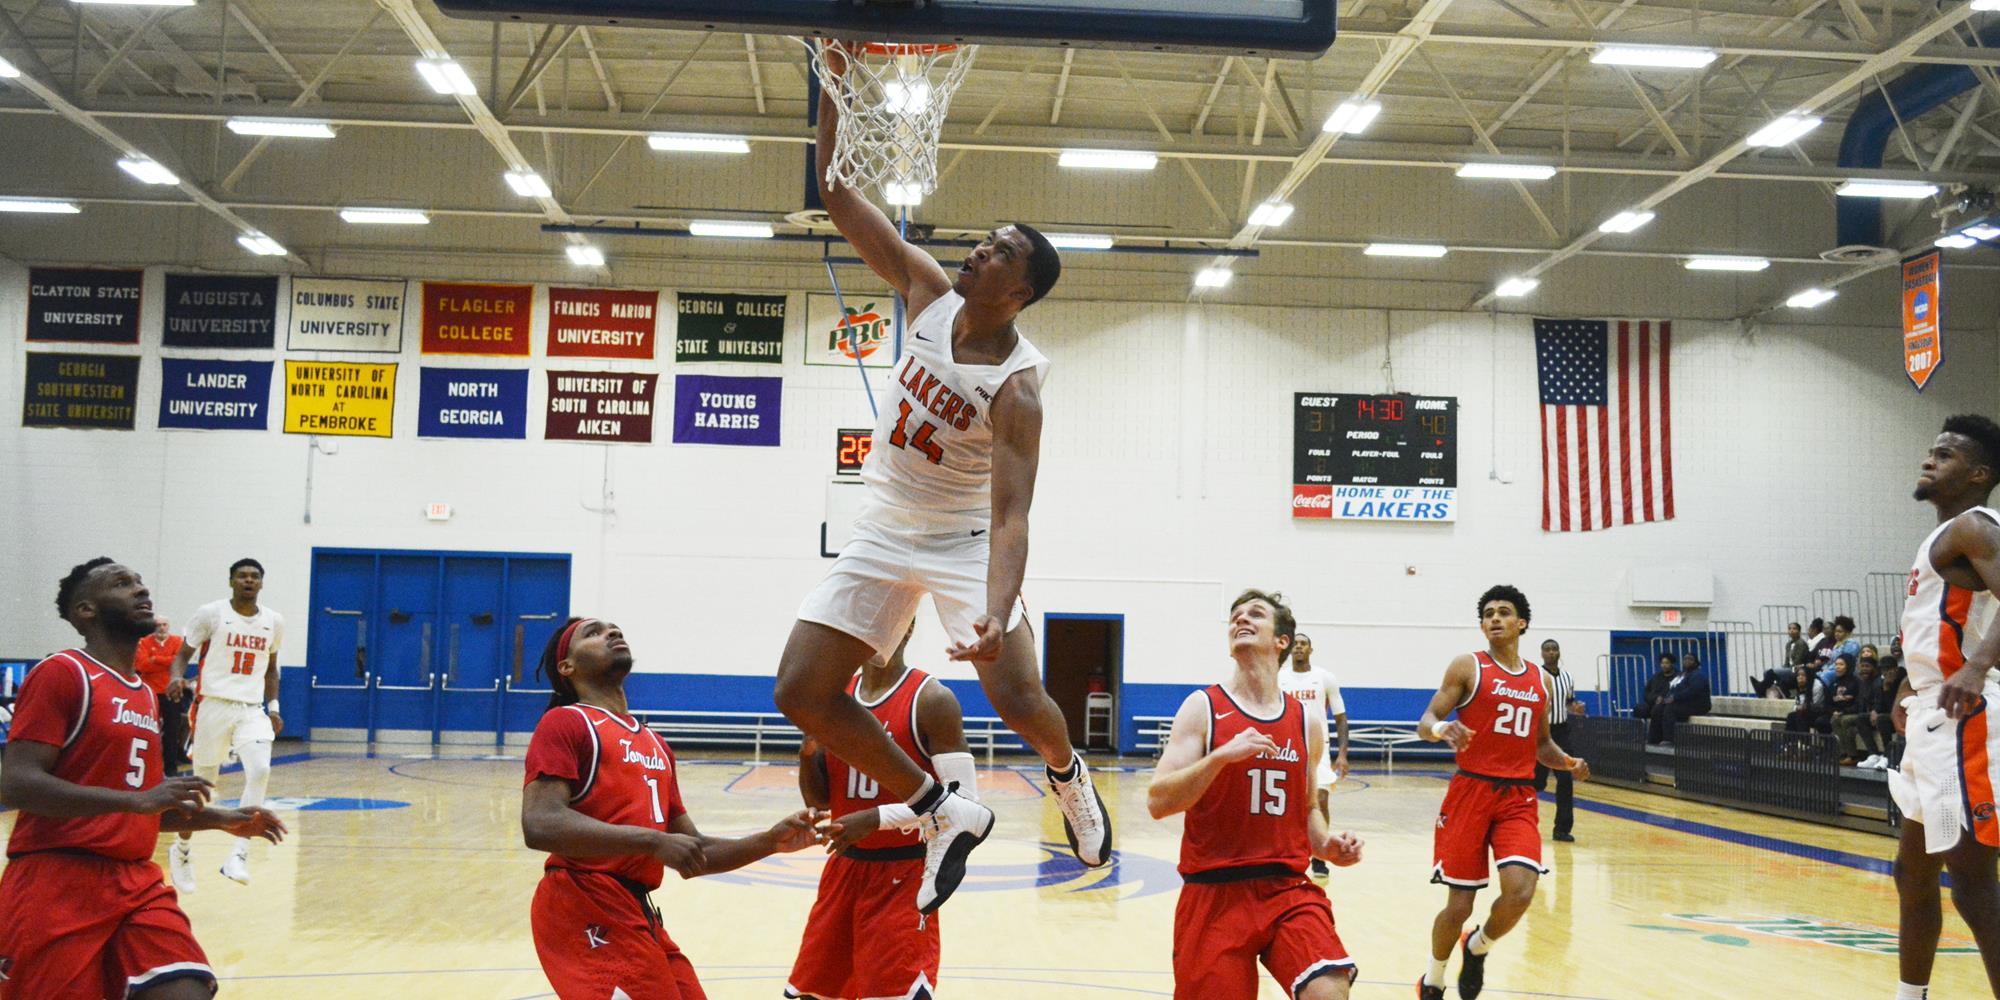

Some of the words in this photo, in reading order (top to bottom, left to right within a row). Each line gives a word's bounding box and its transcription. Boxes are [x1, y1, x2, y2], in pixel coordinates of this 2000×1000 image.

[32, 285, 91, 298] CLAYTON
[98, 287, 139, 299] STATE
[180, 291, 264, 306] AUGUSTA
[296, 292, 354, 307] COLUMBUS
[367, 295, 399, 311] STATE
[439, 298, 515, 314] FLAGLER
[554, 300, 600, 317] FRANCIS
[611, 303, 652, 319] MARION
[678, 299, 724, 315] GEORGIA
[736, 302, 785, 318] COLLEGE
[44, 312, 123, 326] UNIVERSITY
[169, 317, 271, 333] UNIVERSITY
[300, 320, 391, 337] UNIVERSITY
[439, 325, 514, 341] COLLEGE
[828, 318, 891, 351] PBC
[557, 329, 645, 346] UNIVERSITY
[677, 339, 708, 354] STATE
[718, 340, 783, 356] UNIVERSITY
[58, 361, 105, 378] GEORGIA
[1909, 351, 1932, 372] 2007
[187, 372, 248, 389] LANDER
[296, 367, 361, 382] UNIVERSITY
[371, 369, 386, 382] OF
[37, 384, 125, 398] SOUTHWESTERN
[291, 383, 325, 397] NORTH
[336, 384, 389, 400] CAROLINA
[448, 382, 498, 397] NORTH
[557, 377, 623, 393] UNIVERSITY
[632, 379, 647, 394] OF
[898, 355, 978, 432] LAKERS
[169, 400, 258, 418] UNIVERSITY
[332, 402, 346, 412] AT
[552, 398, 587, 414] SOUTH
[597, 399, 650, 416] CAROLINA
[700, 392, 757, 409] YOUNG
[1301, 397, 1338, 408] GUEST
[1415, 400, 1448, 410] HOME
[27, 403, 60, 417] STATE
[67, 405, 132, 421] UNIVERSITY
[440, 409, 504, 425] GEORGIA
[695, 412, 760, 429] HARRIS
[300, 414, 377, 431] PEMBROKE
[577, 419, 621, 436] AIKEN
[889, 398, 945, 465] 14
[1346, 431, 1379, 440] PERIOD
[1308, 449, 1331, 457] FOULS
[1421, 452, 1443, 460] FOULS
[1352, 476, 1378, 484] MATCH
[1336, 487, 1385, 498] HOME
[1393, 488, 1415, 499] OF
[1423, 489, 1454, 500] THE
[1342, 501, 1449, 519] LAKERS
[226, 632, 267, 651] LAKERS
[231, 650, 256, 676] 12
[1491, 678, 1540, 702] Tornado
[1493, 702, 1533, 738] 20
[125, 737, 149, 788] 5
[1247, 768, 1287, 816] 15
[584, 926, 611, 949] K
